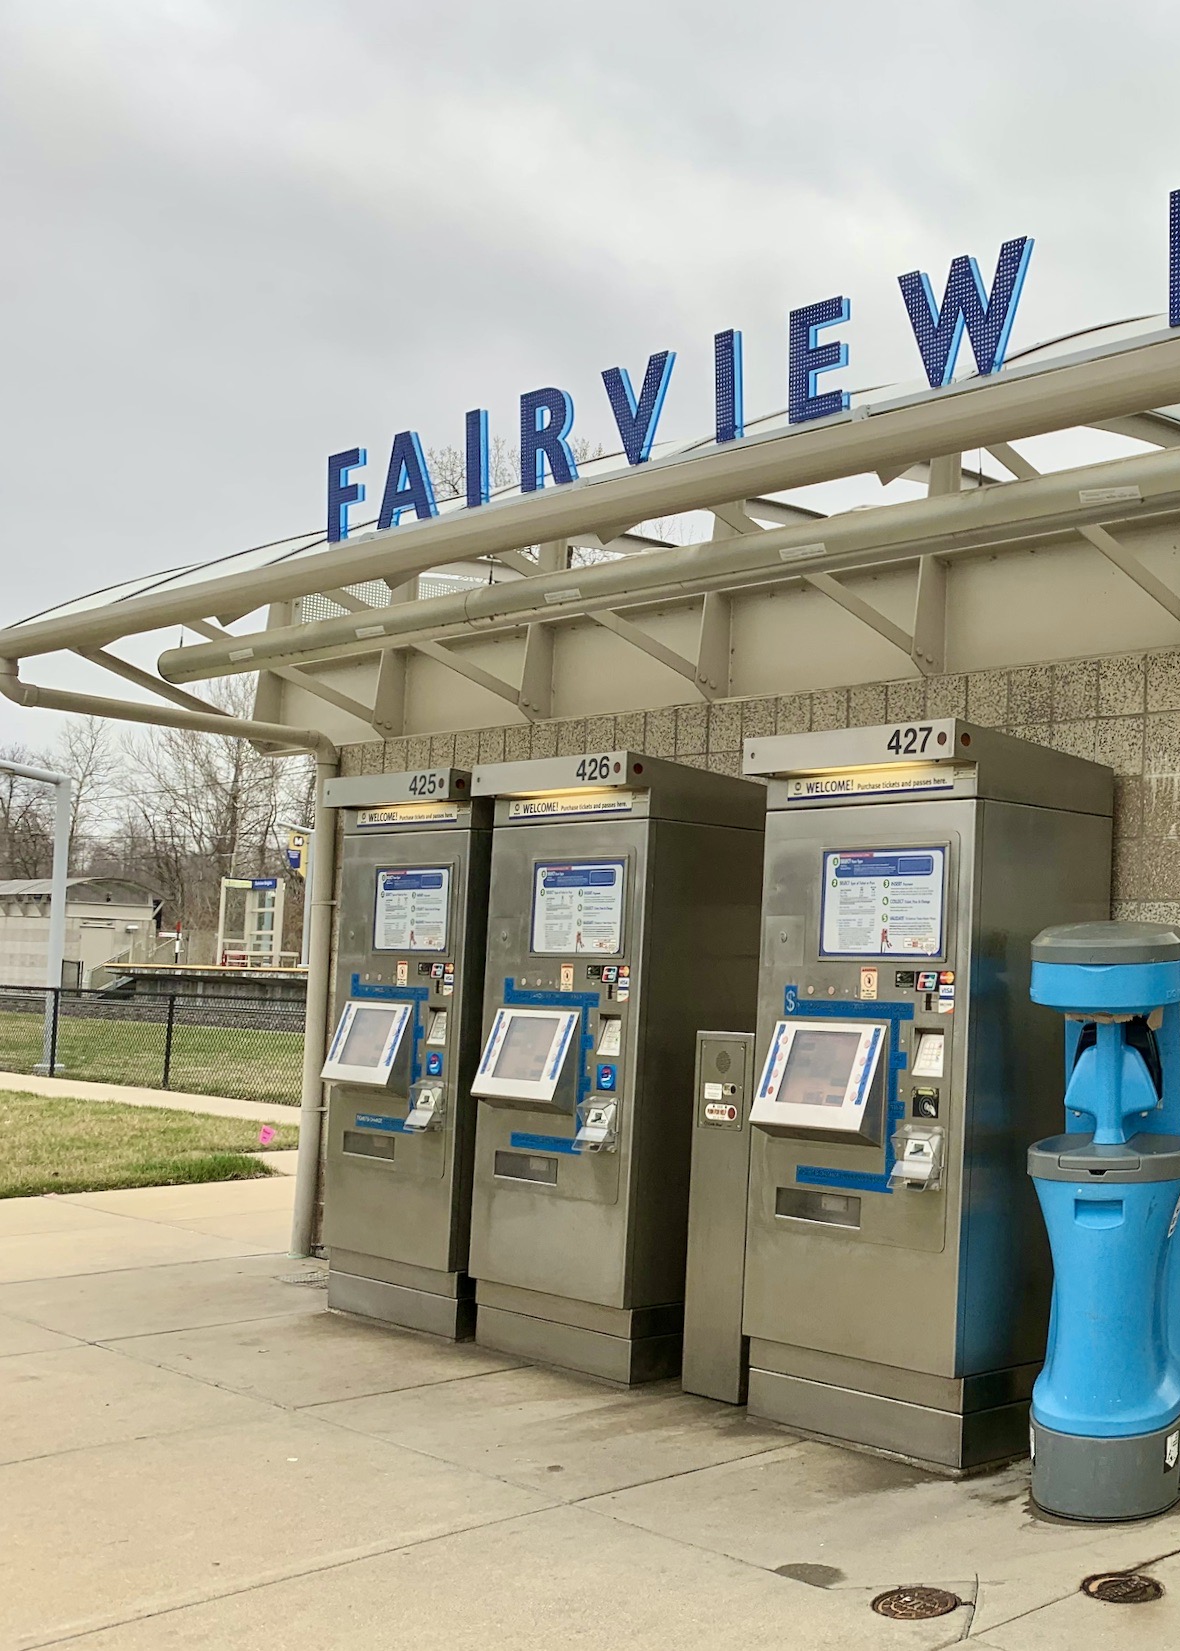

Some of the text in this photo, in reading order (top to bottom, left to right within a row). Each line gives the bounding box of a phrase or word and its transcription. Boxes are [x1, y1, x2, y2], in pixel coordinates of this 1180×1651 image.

[327, 236, 1035, 543] FAIRVIEW
[887, 727, 933, 755] 427
[576, 756, 610, 781] 426
[409, 774, 436, 795] 425
[806, 779, 854, 794] WELCOME!
[912, 780, 932, 788] passes
[368, 812, 398, 822] WELCOME!
[523, 802, 558, 814] WELCOME!
